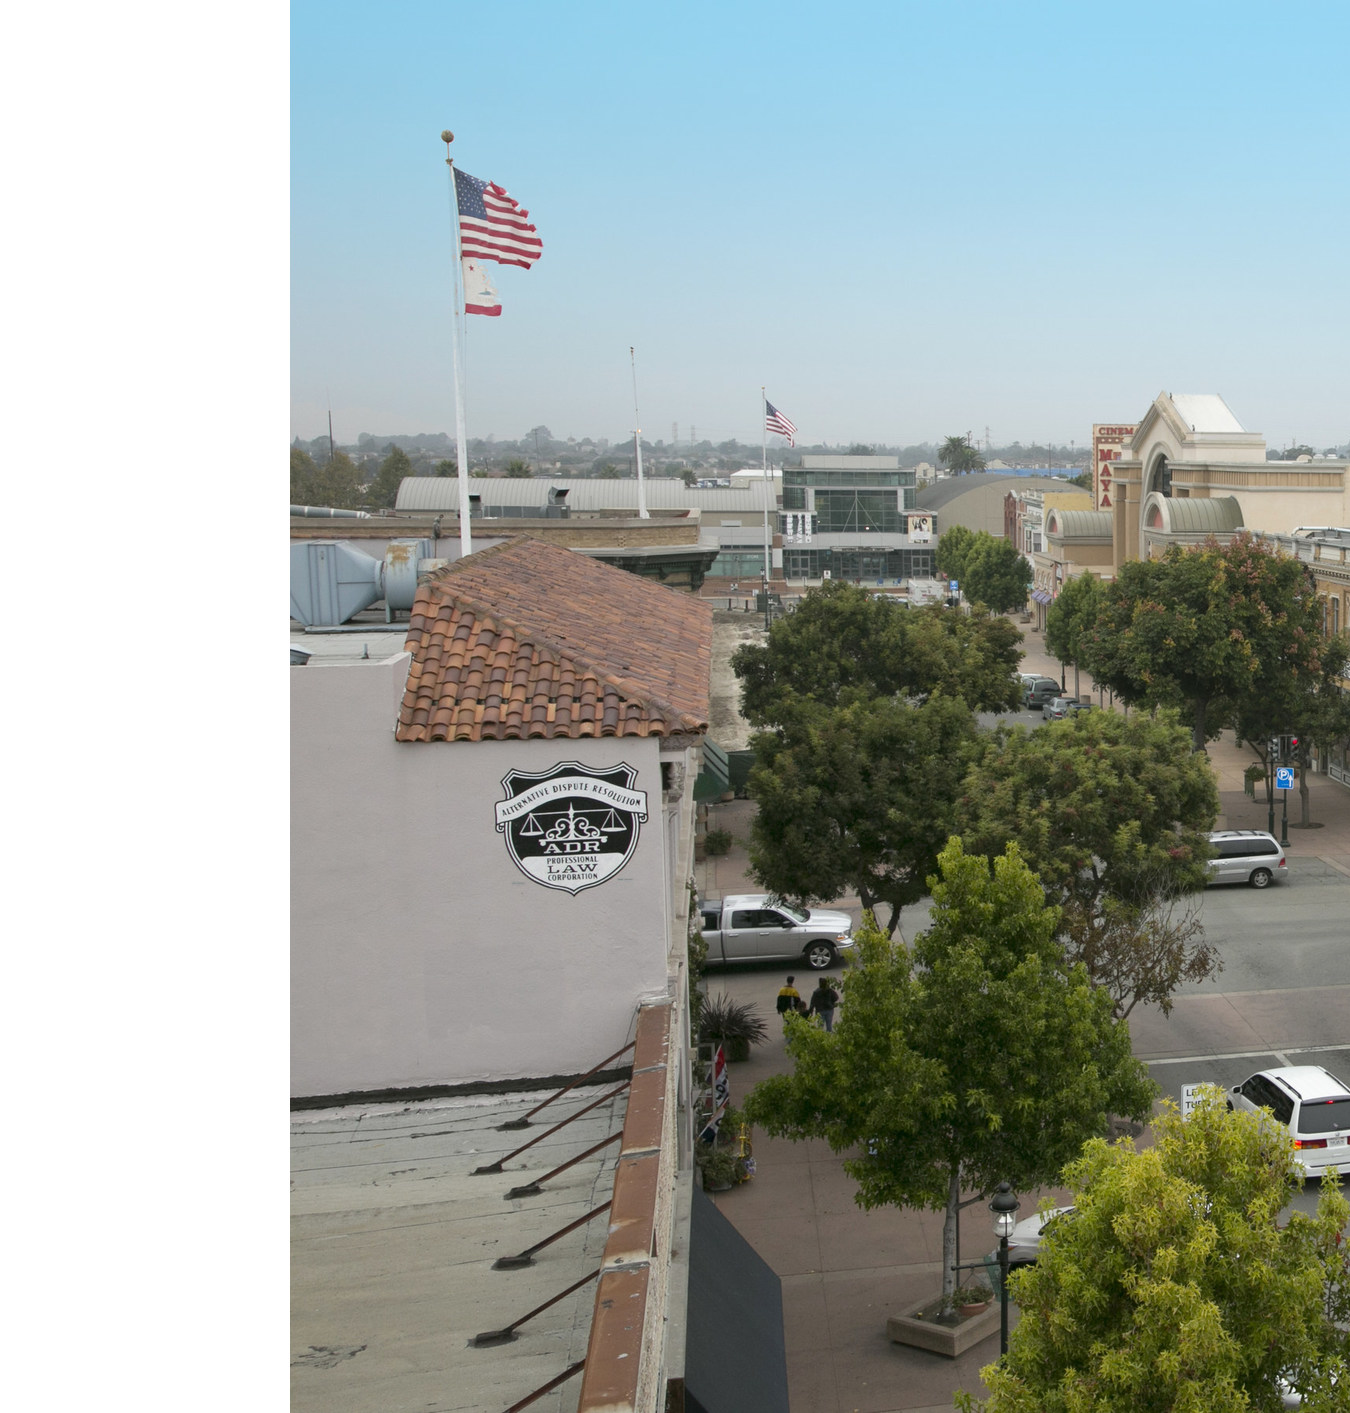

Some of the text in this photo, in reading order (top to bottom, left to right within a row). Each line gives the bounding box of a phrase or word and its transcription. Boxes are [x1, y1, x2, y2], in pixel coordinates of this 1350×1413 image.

[1098, 427, 1138, 435] CINEM
[1099, 449, 1112, 507] MAYA
[501, 782, 641, 817] ALTERNATIVE DISPUTE RESOLUTION
[544, 841, 601, 854] ADR
[546, 855, 599, 864] PROFESSIONAL
[547, 863, 599, 874] LAW
[547, 873, 599, 881] CORPORATION
